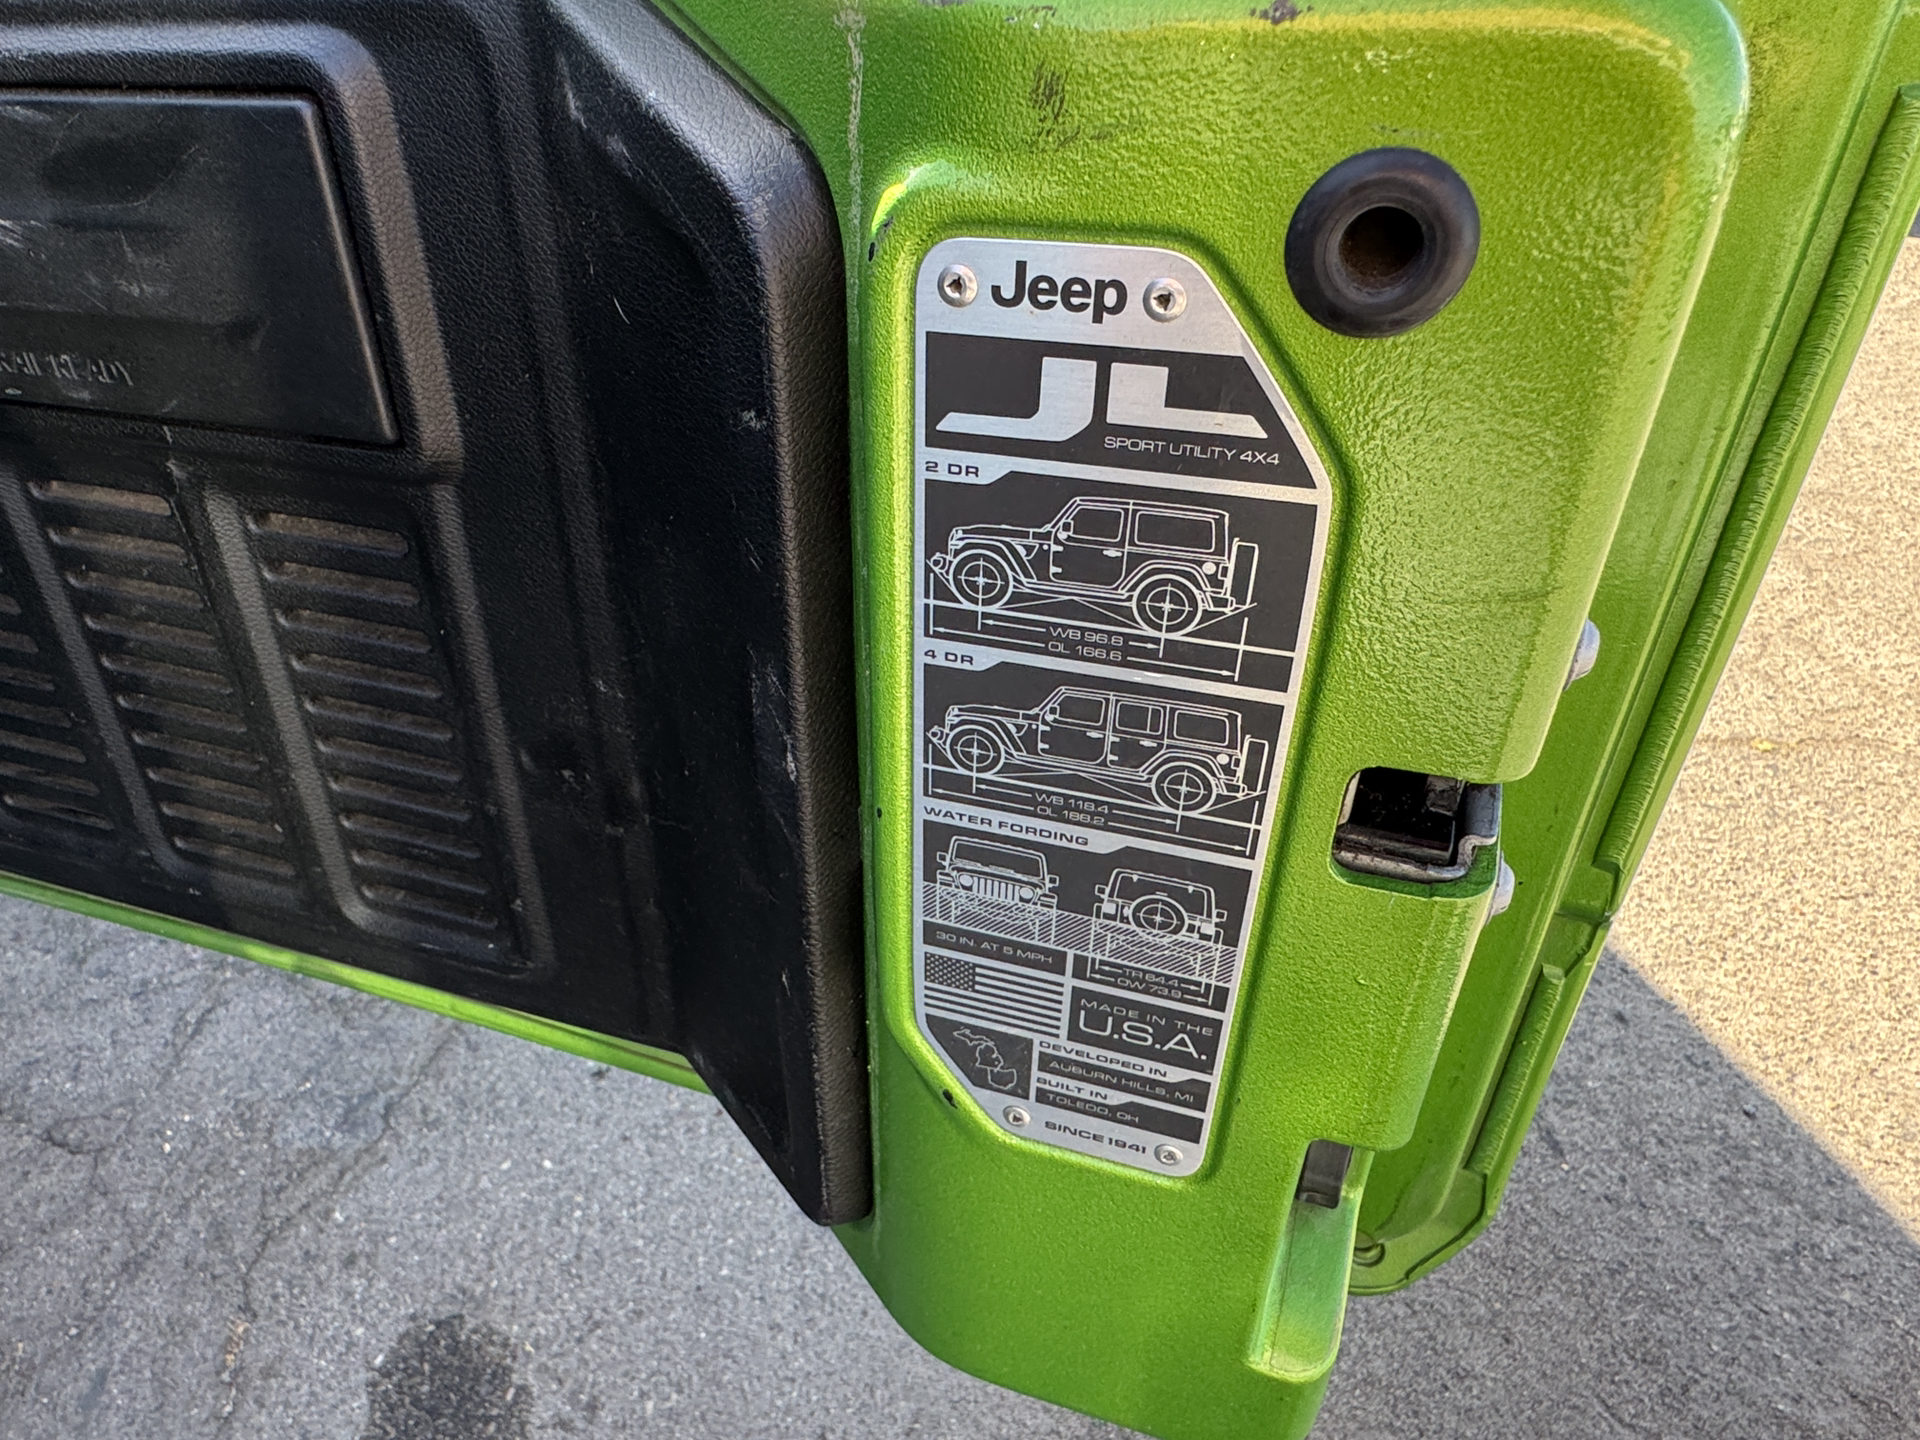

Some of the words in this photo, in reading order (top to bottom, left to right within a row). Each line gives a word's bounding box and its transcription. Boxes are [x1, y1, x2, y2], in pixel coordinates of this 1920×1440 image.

[991, 260, 1128, 324] Jeep
[936, 356, 1268, 442] JL
[1104, 436, 1167, 454] SPORT
[1169, 443, 1235, 461] UTILITY
[1239, 449, 1279, 466] 4X4
[925, 460, 938, 473] 2
[947, 463, 979, 477] DR
[1048, 642, 1071, 654] OL
[1049, 626, 1081, 640] WB
[1084, 631, 1124, 647] 96.8
[924, 649, 937, 659] 4
[944, 651, 974, 666] DR
[1035, 792, 1064, 806] WB
[1068, 799, 1109, 814] 118.4
[1037, 807, 1057, 817] OL
[1063, 810, 1105, 825] 188.2
[924, 806, 992, 827] WATER
[999, 820, 1089, 846] FORDING
[936, 930, 957, 942] 30
[959, 936, 977, 948] IN.
[981, 940, 1001, 951] AT
[1003, 944, 1013, 955] 5
[1017, 947, 1053, 964] MPH
[1117, 978, 1147, 990] OW
[1123, 968, 1143, 980] TR
[1145, 971, 1179, 987] 64.4
[1081, 998, 1139, 1018] MADE
[1147, 1013, 1166, 1025] IN
[1174, 1019, 1213, 1036] THE
[1079, 1010, 1207, 1060] U.S.A.
[1039, 1040, 1144, 1072] DEVELOPED
[1149, 1068, 1167, 1078] IN
[1036, 1077, 1085, 1094] BUILT
[1089, 1090, 1108, 1100] IN
[1049, 1060, 1117, 1084] AUBURN
[1121, 1078, 1170, 1097] HILLS,
[1174, 1091, 1194, 1102] MI
[1046, 1093, 1113, 1117] TOLEDO,
[1116, 1111, 1139, 1123] OH
[1045, 1121, 1104, 1143] SINCE
[1108, 1138, 1147, 1154] 1941
